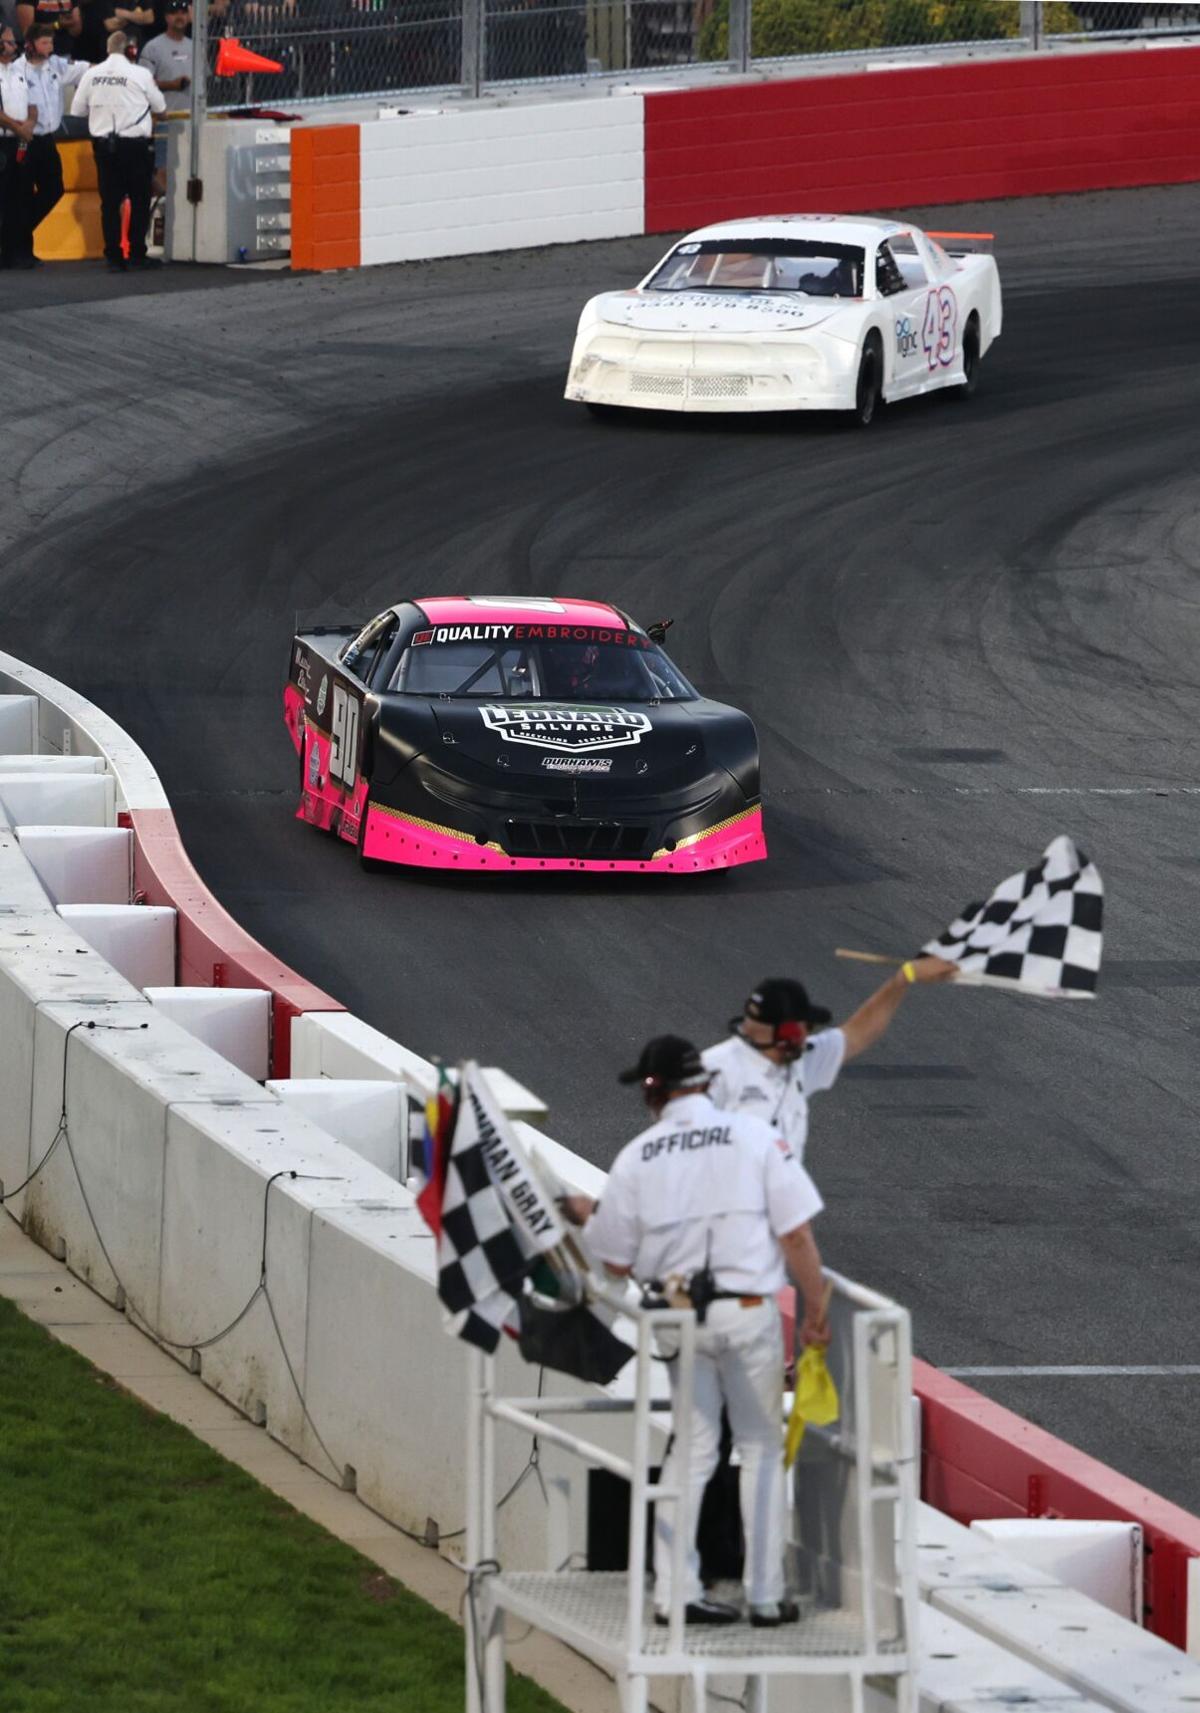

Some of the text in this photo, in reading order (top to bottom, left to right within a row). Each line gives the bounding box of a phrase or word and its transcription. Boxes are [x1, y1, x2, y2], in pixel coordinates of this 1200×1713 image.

[92, 76, 127, 87] OFFICIAL
[922, 285, 957, 372] 43
[437, 625, 650, 649] QUALITY EMBROIDERY
[484, 706, 646, 726] LEONARD
[520, 722, 614, 732] SALVAGE
[329, 683, 360, 788] 90
[641, 1126, 734, 1162] OFFICIAL
[510, 1180, 554, 1235] GRAY
